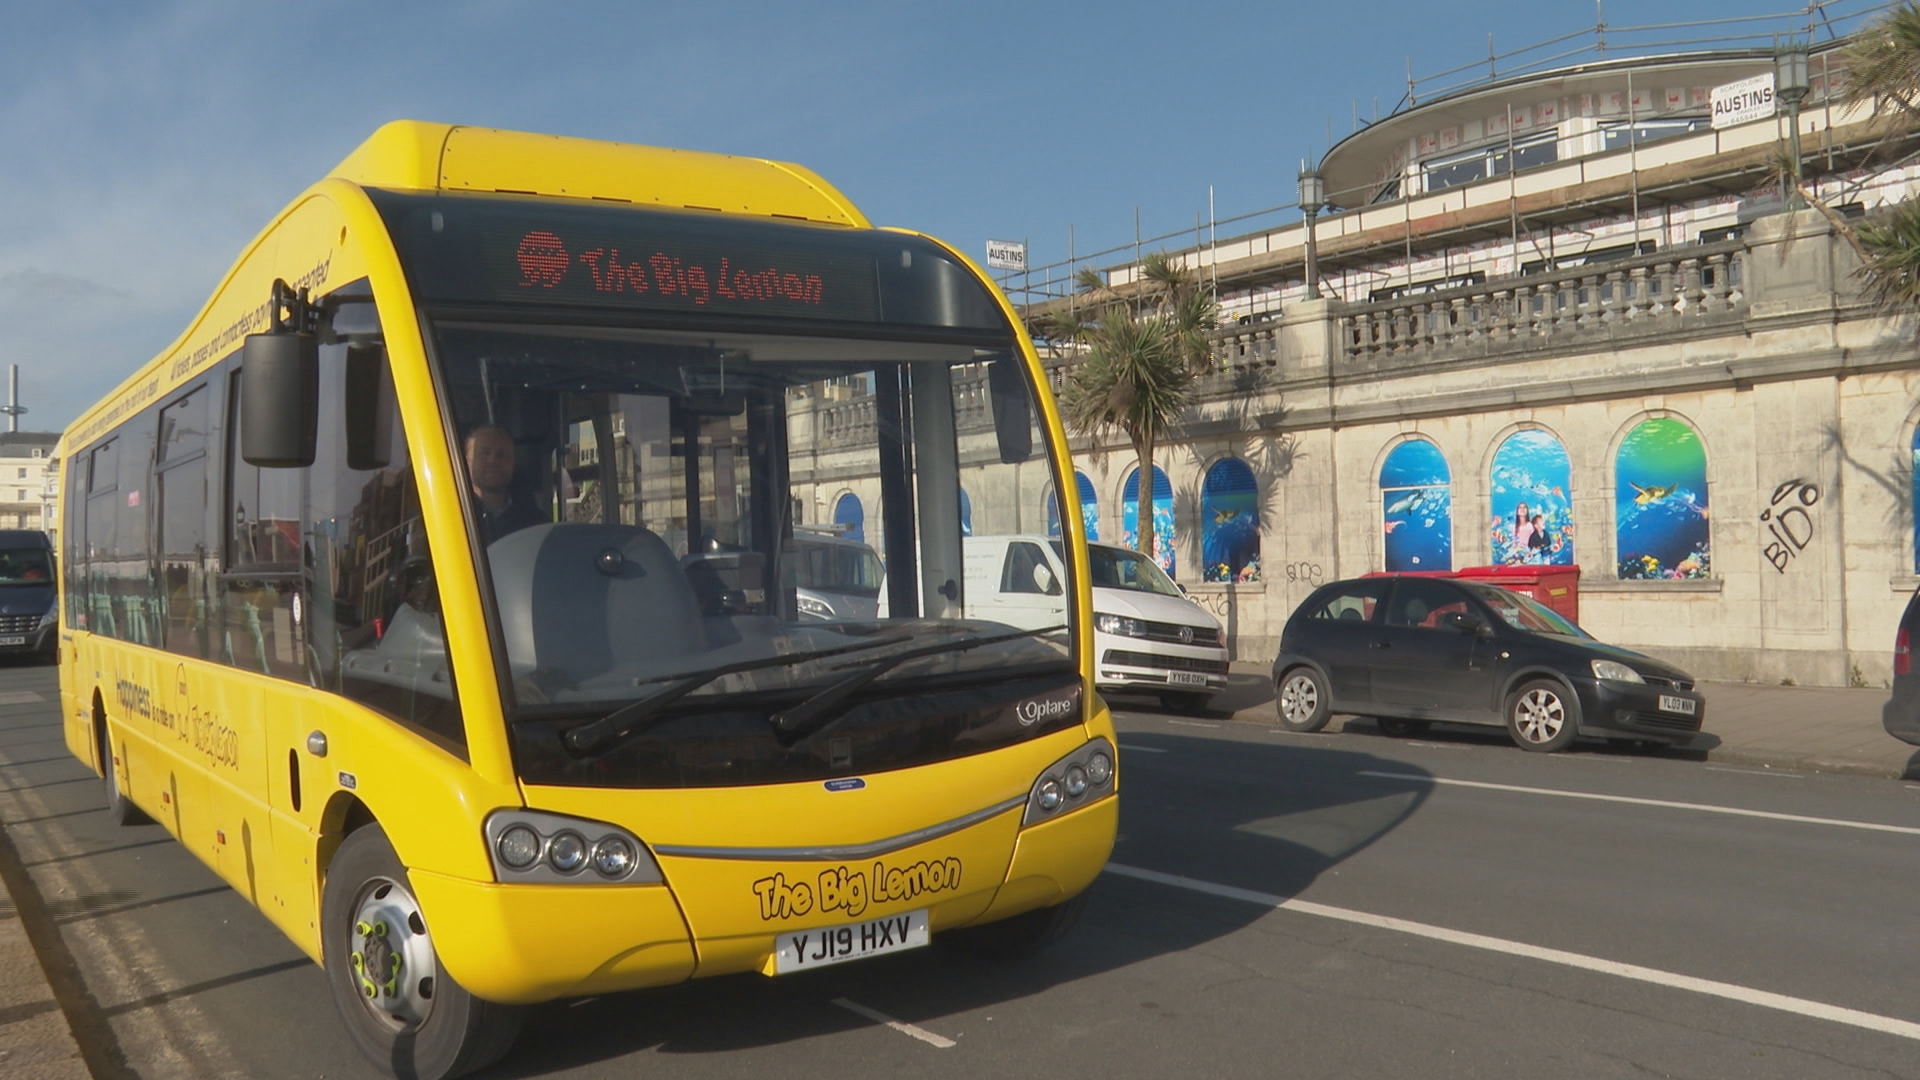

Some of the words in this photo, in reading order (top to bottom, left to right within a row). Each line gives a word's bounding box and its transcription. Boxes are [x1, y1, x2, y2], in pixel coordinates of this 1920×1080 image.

[1715, 87, 1772, 116] AUSTINS
[1720, 77, 1764, 93] SCAFFOLDING
[990, 248, 1023, 262] AUSTINS
[580, 248, 648, 293] The
[650, 252, 710, 304] Big
[716, 257, 823, 304] Lemon
[115, 667, 151, 720] Happiness
[1022, 698, 1071, 725] Optare
[753, 872, 813, 921] The
[818, 866, 869, 917] Big
[872, 856, 962, 903] Lemon
[792, 927, 853, 964] YJ19
[861, 915, 911, 951] HXV
